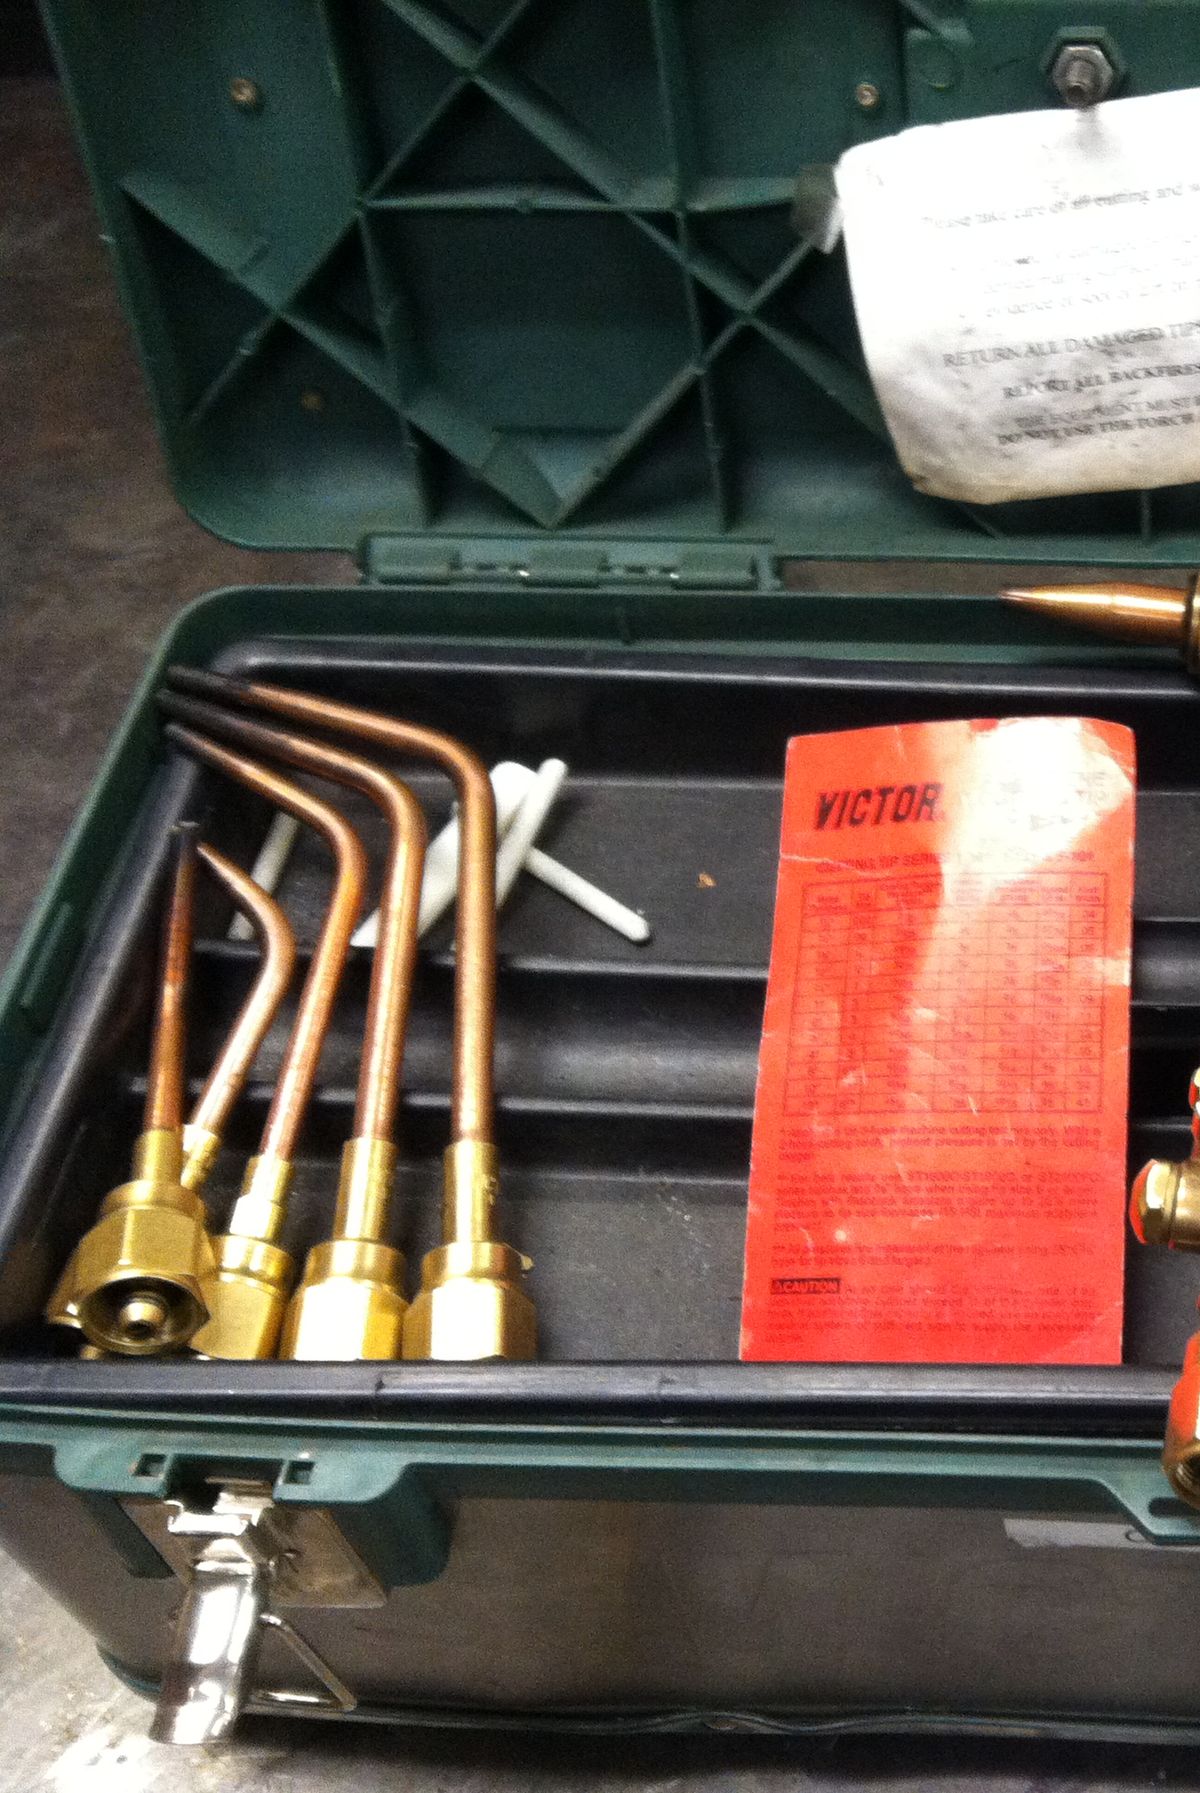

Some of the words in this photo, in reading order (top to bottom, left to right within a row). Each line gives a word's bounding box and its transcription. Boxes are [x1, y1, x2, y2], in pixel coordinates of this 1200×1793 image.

[941, 346, 1021, 367] RETURN
[1023, 340, 1058, 358] ALL
[815, 782, 942, 830] VICTOR
[783, 1280, 839, 1294] CAUTION
